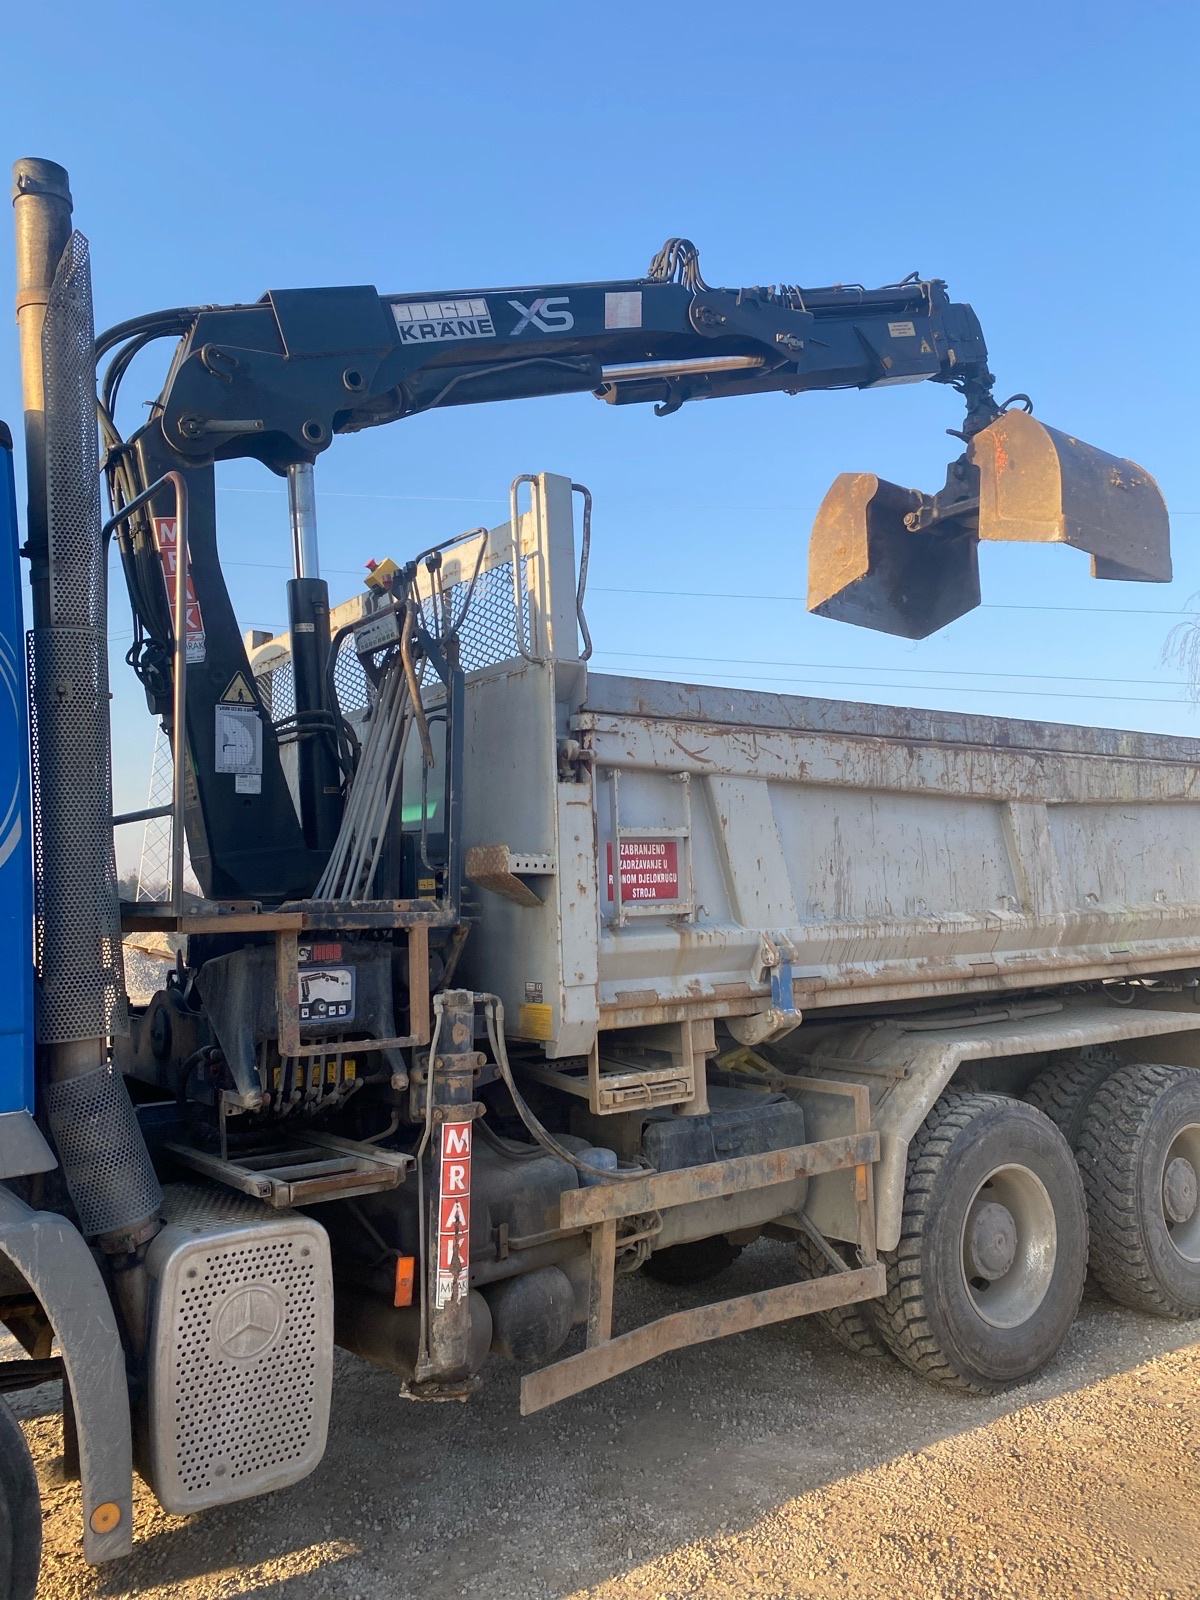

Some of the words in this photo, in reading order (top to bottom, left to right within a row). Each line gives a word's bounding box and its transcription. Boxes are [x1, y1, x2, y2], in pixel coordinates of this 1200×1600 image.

[507, 296, 574, 335] XS
[400, 319, 494, 341] KRÄNE
[620, 844, 666, 855] ZABRANJENO
[620, 857, 662, 870] ZADRŽAVANJE
[663, 860, 668, 869] U
[608, 873, 637, 885] RNOM
[638, 872, 677, 884] DJELOKRUGU
[632, 887, 656, 898] STROJA
